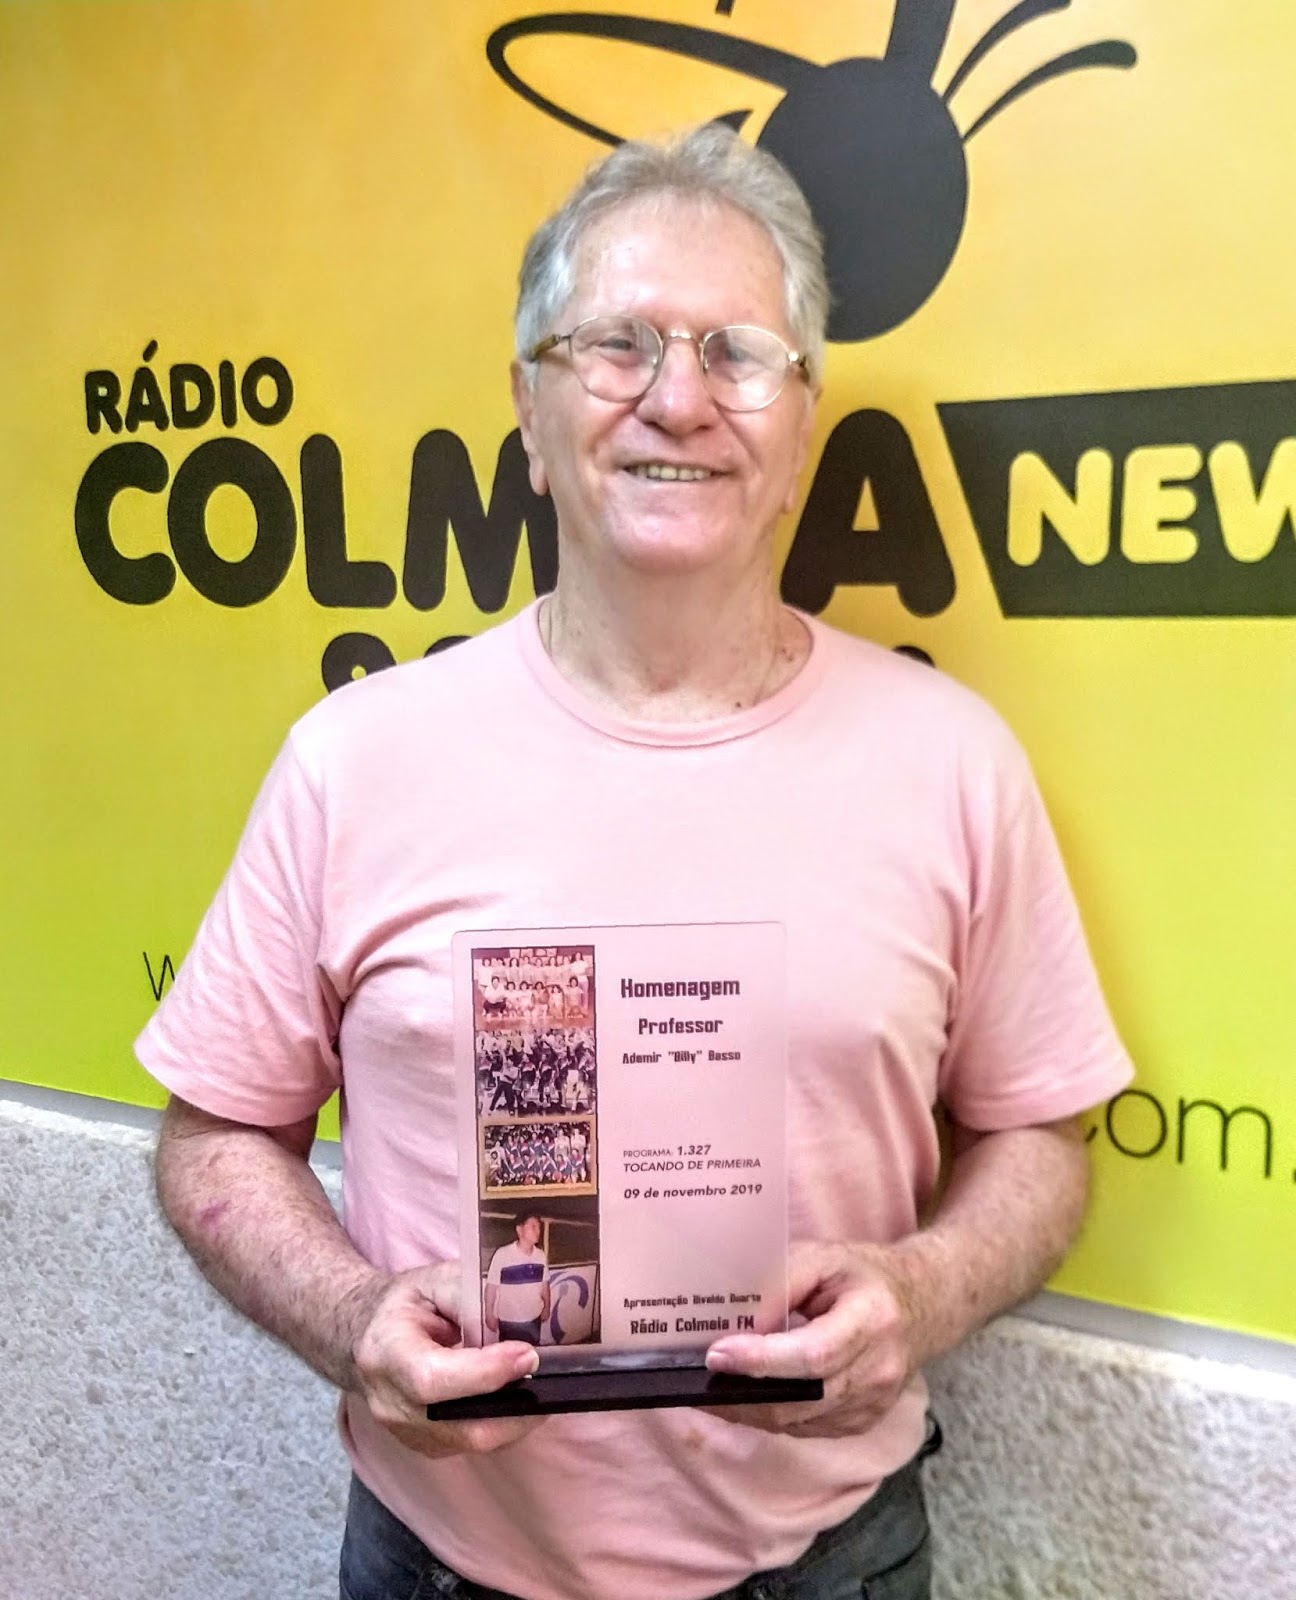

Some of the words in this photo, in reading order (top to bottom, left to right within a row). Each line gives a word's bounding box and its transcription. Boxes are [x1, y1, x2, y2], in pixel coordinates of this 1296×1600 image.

[84, 339, 294, 434] RÁDIO
[620, 978, 741, 1001] Homenagem
[638, 1017, 724, 1035] Professor
[622, 1051, 662, 1064] Ademir
[708, 1049, 741, 1062] Basso
[677, 1144, 712, 1156] 1.327
[623, 1161, 684, 1173] TOCANDO
[687, 1160, 704, 1170] DE
[706, 1158, 762, 1169] PRIMEIRA
[623, 1188, 641, 1199] 09
[643, 1187, 660, 1198] de
[663, 1185, 727, 1198] novembro
[730, 1183, 763, 1196] 2019
[630, 1318, 668, 1335] Rádio
[675, 1316, 730, 1333] Colmeia
[737, 1315, 755, 1330] FM
